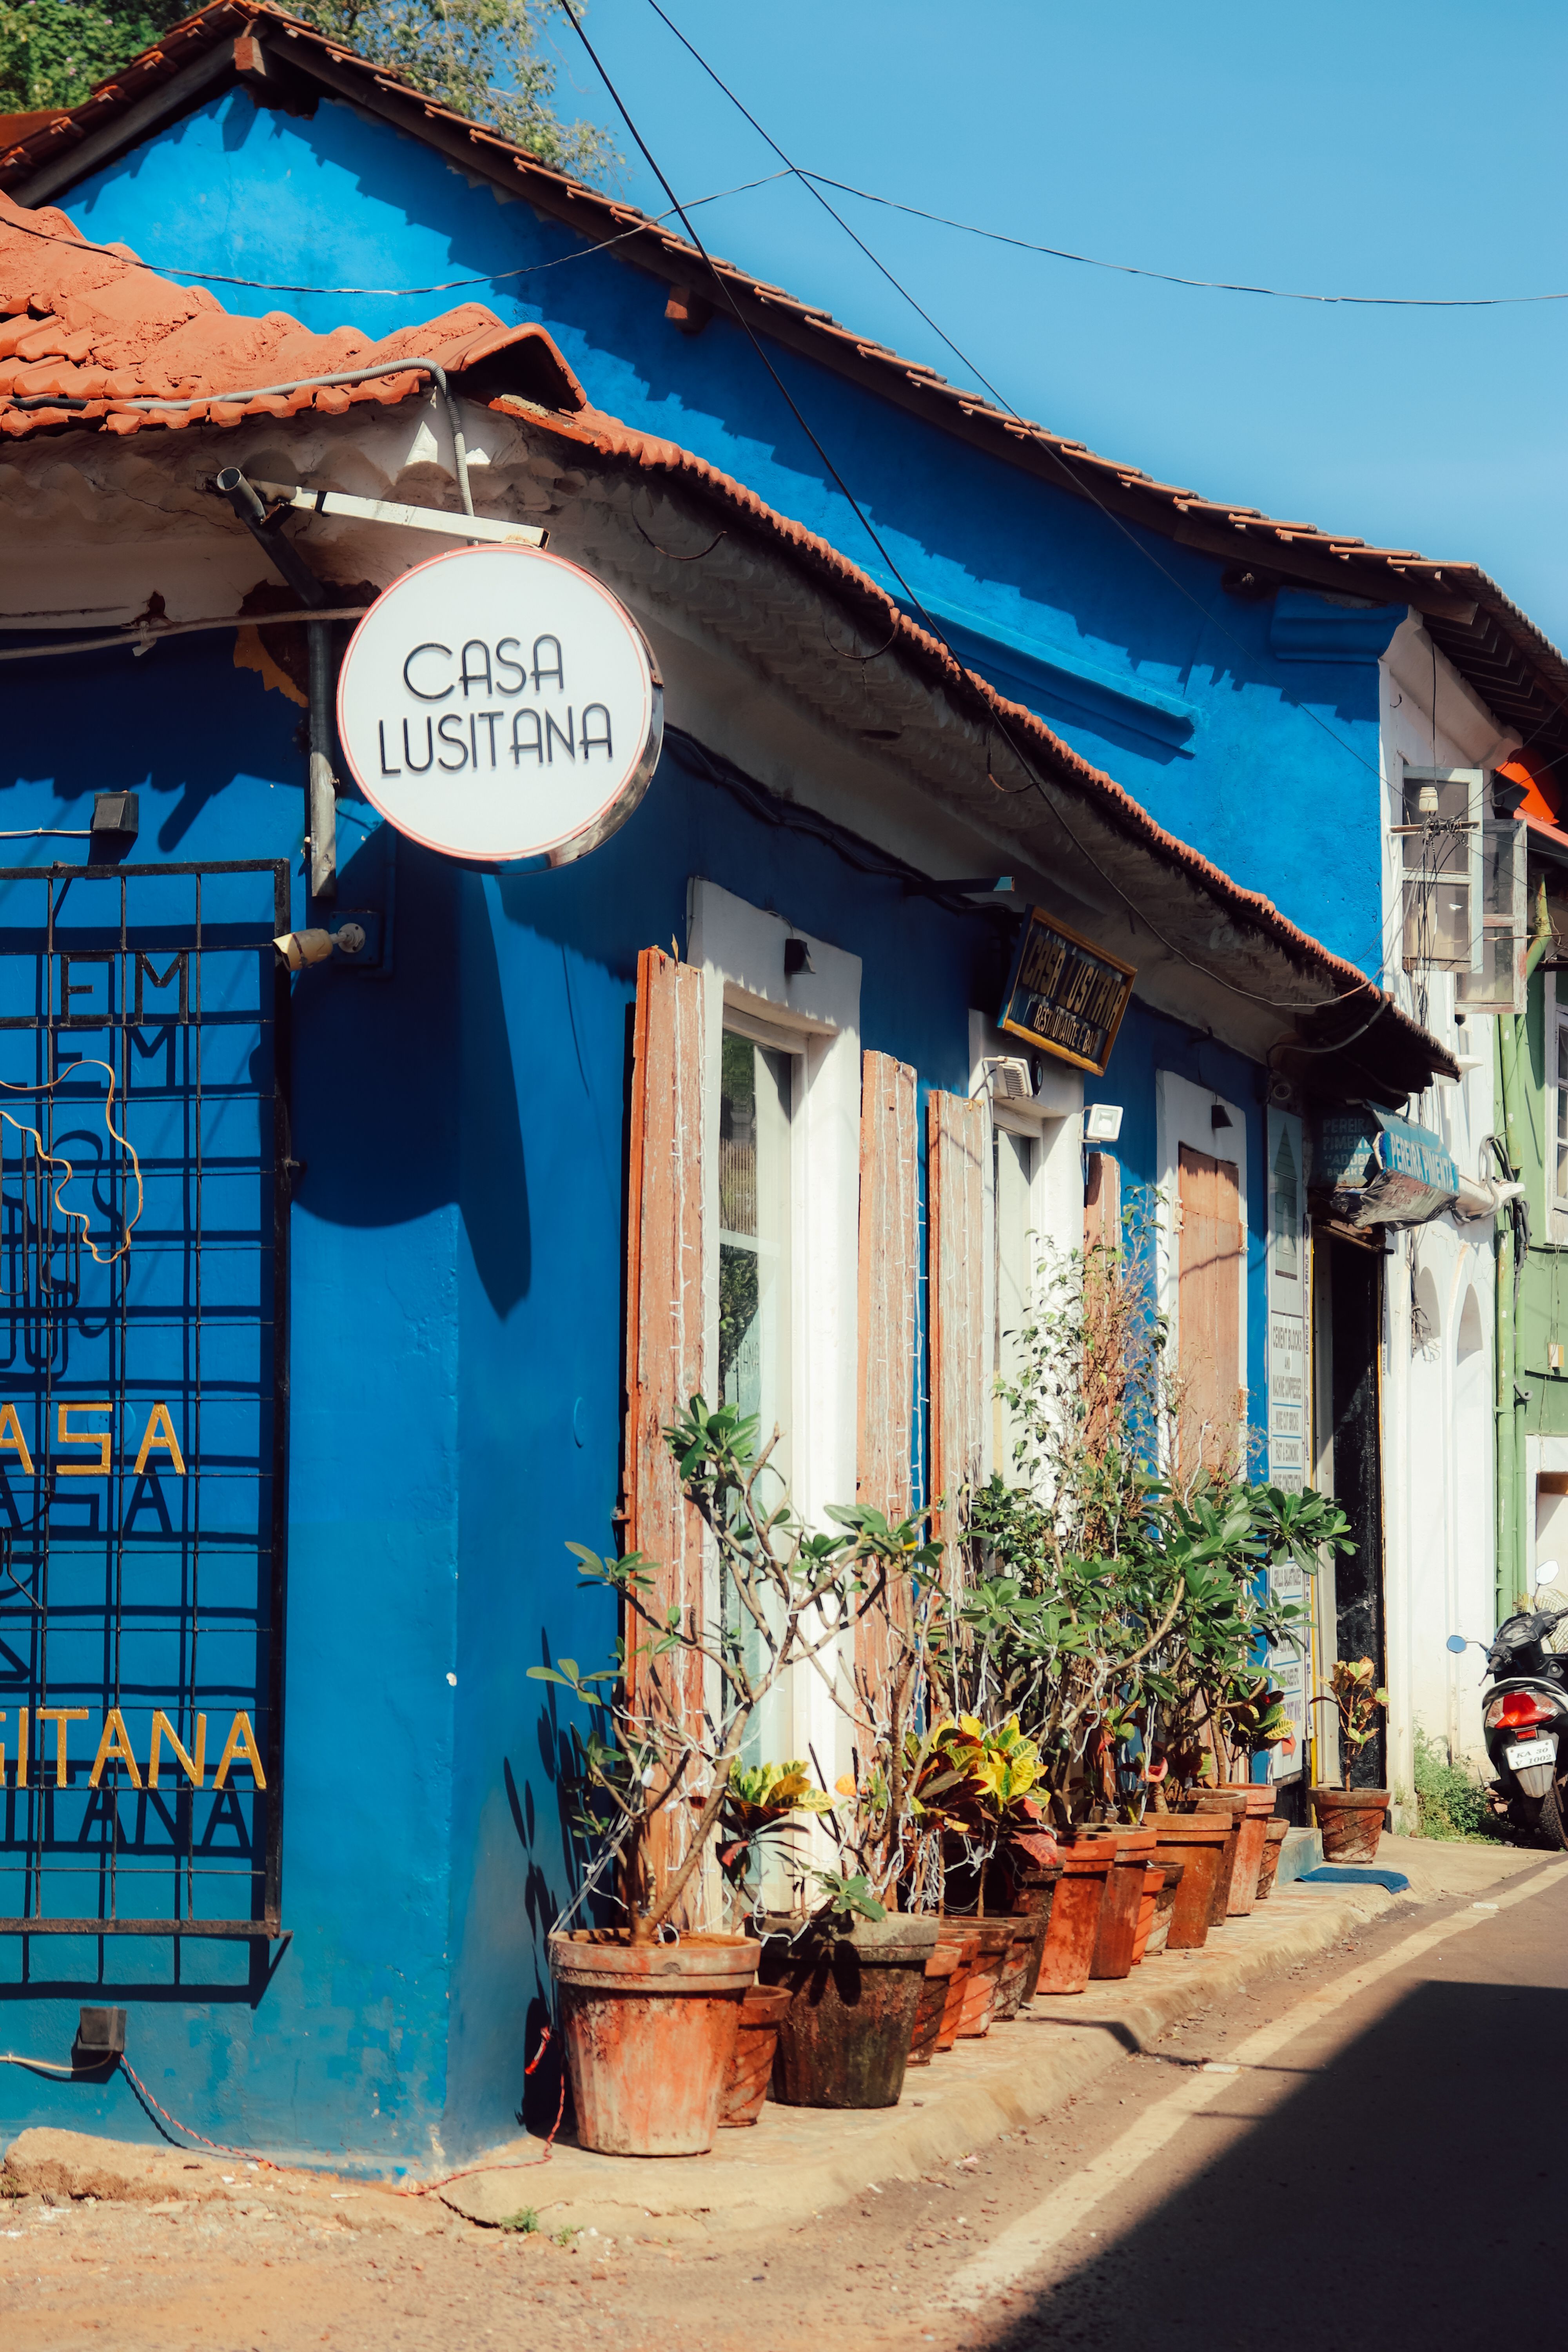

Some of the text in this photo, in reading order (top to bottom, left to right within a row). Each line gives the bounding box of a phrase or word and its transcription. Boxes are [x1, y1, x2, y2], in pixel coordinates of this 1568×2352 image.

[403, 633, 564, 701] CASA
[379, 703, 613, 775] LUSITANA
[0, 952, 189, 1026] EM
[1022, 935, 1126, 1032] CASA LUSITANA
[1033, 1004, 1080, 1047] RESTAURANTE
[1082, 1029, 1099, 1054] BAR
[1323, 1118, 1374, 1133] PEREIRA
[1390, 1132, 1454, 1192] PEREIRA PIMENTA
[1273, 1325, 1302, 1352] CEMENT BLOCKS
[0, 1707, 267, 1789] ITANA
[1528, 1754, 1552, 1764] 1002
